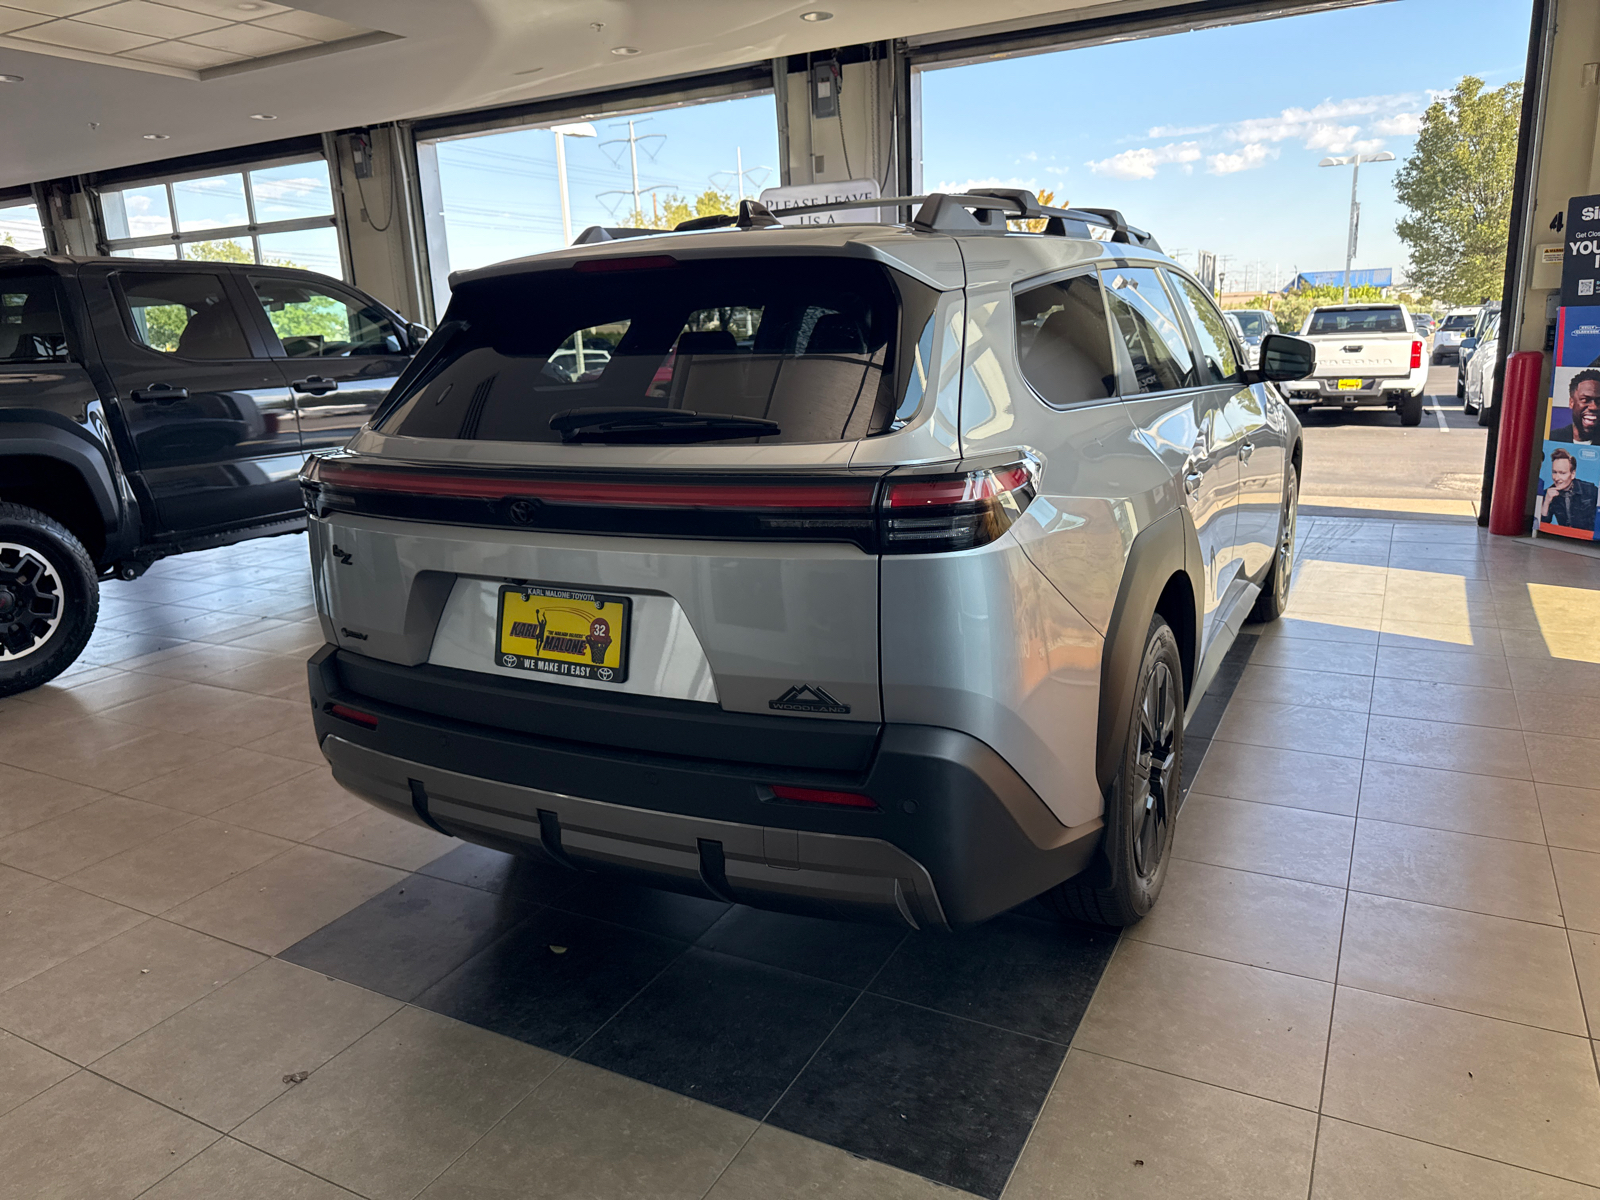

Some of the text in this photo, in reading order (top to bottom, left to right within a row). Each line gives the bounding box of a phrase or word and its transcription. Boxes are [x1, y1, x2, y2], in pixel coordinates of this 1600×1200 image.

[765, 191, 872, 210] PLEASE LEAVE
[1581, 205, 1600, 221] Si
[1549, 211, 1564, 232] 4
[1318, 358, 1393, 366] TACOMA
[527, 588, 595, 602] KARL MALONE TOYOTA
[510, 621, 539, 638] KARL
[593, 624, 606, 637] 32
[543, 636, 587, 656] MALONE
[523, 658, 591, 677] WE MAKE IT EASY
[772, 703, 846, 713] WOODLAND
